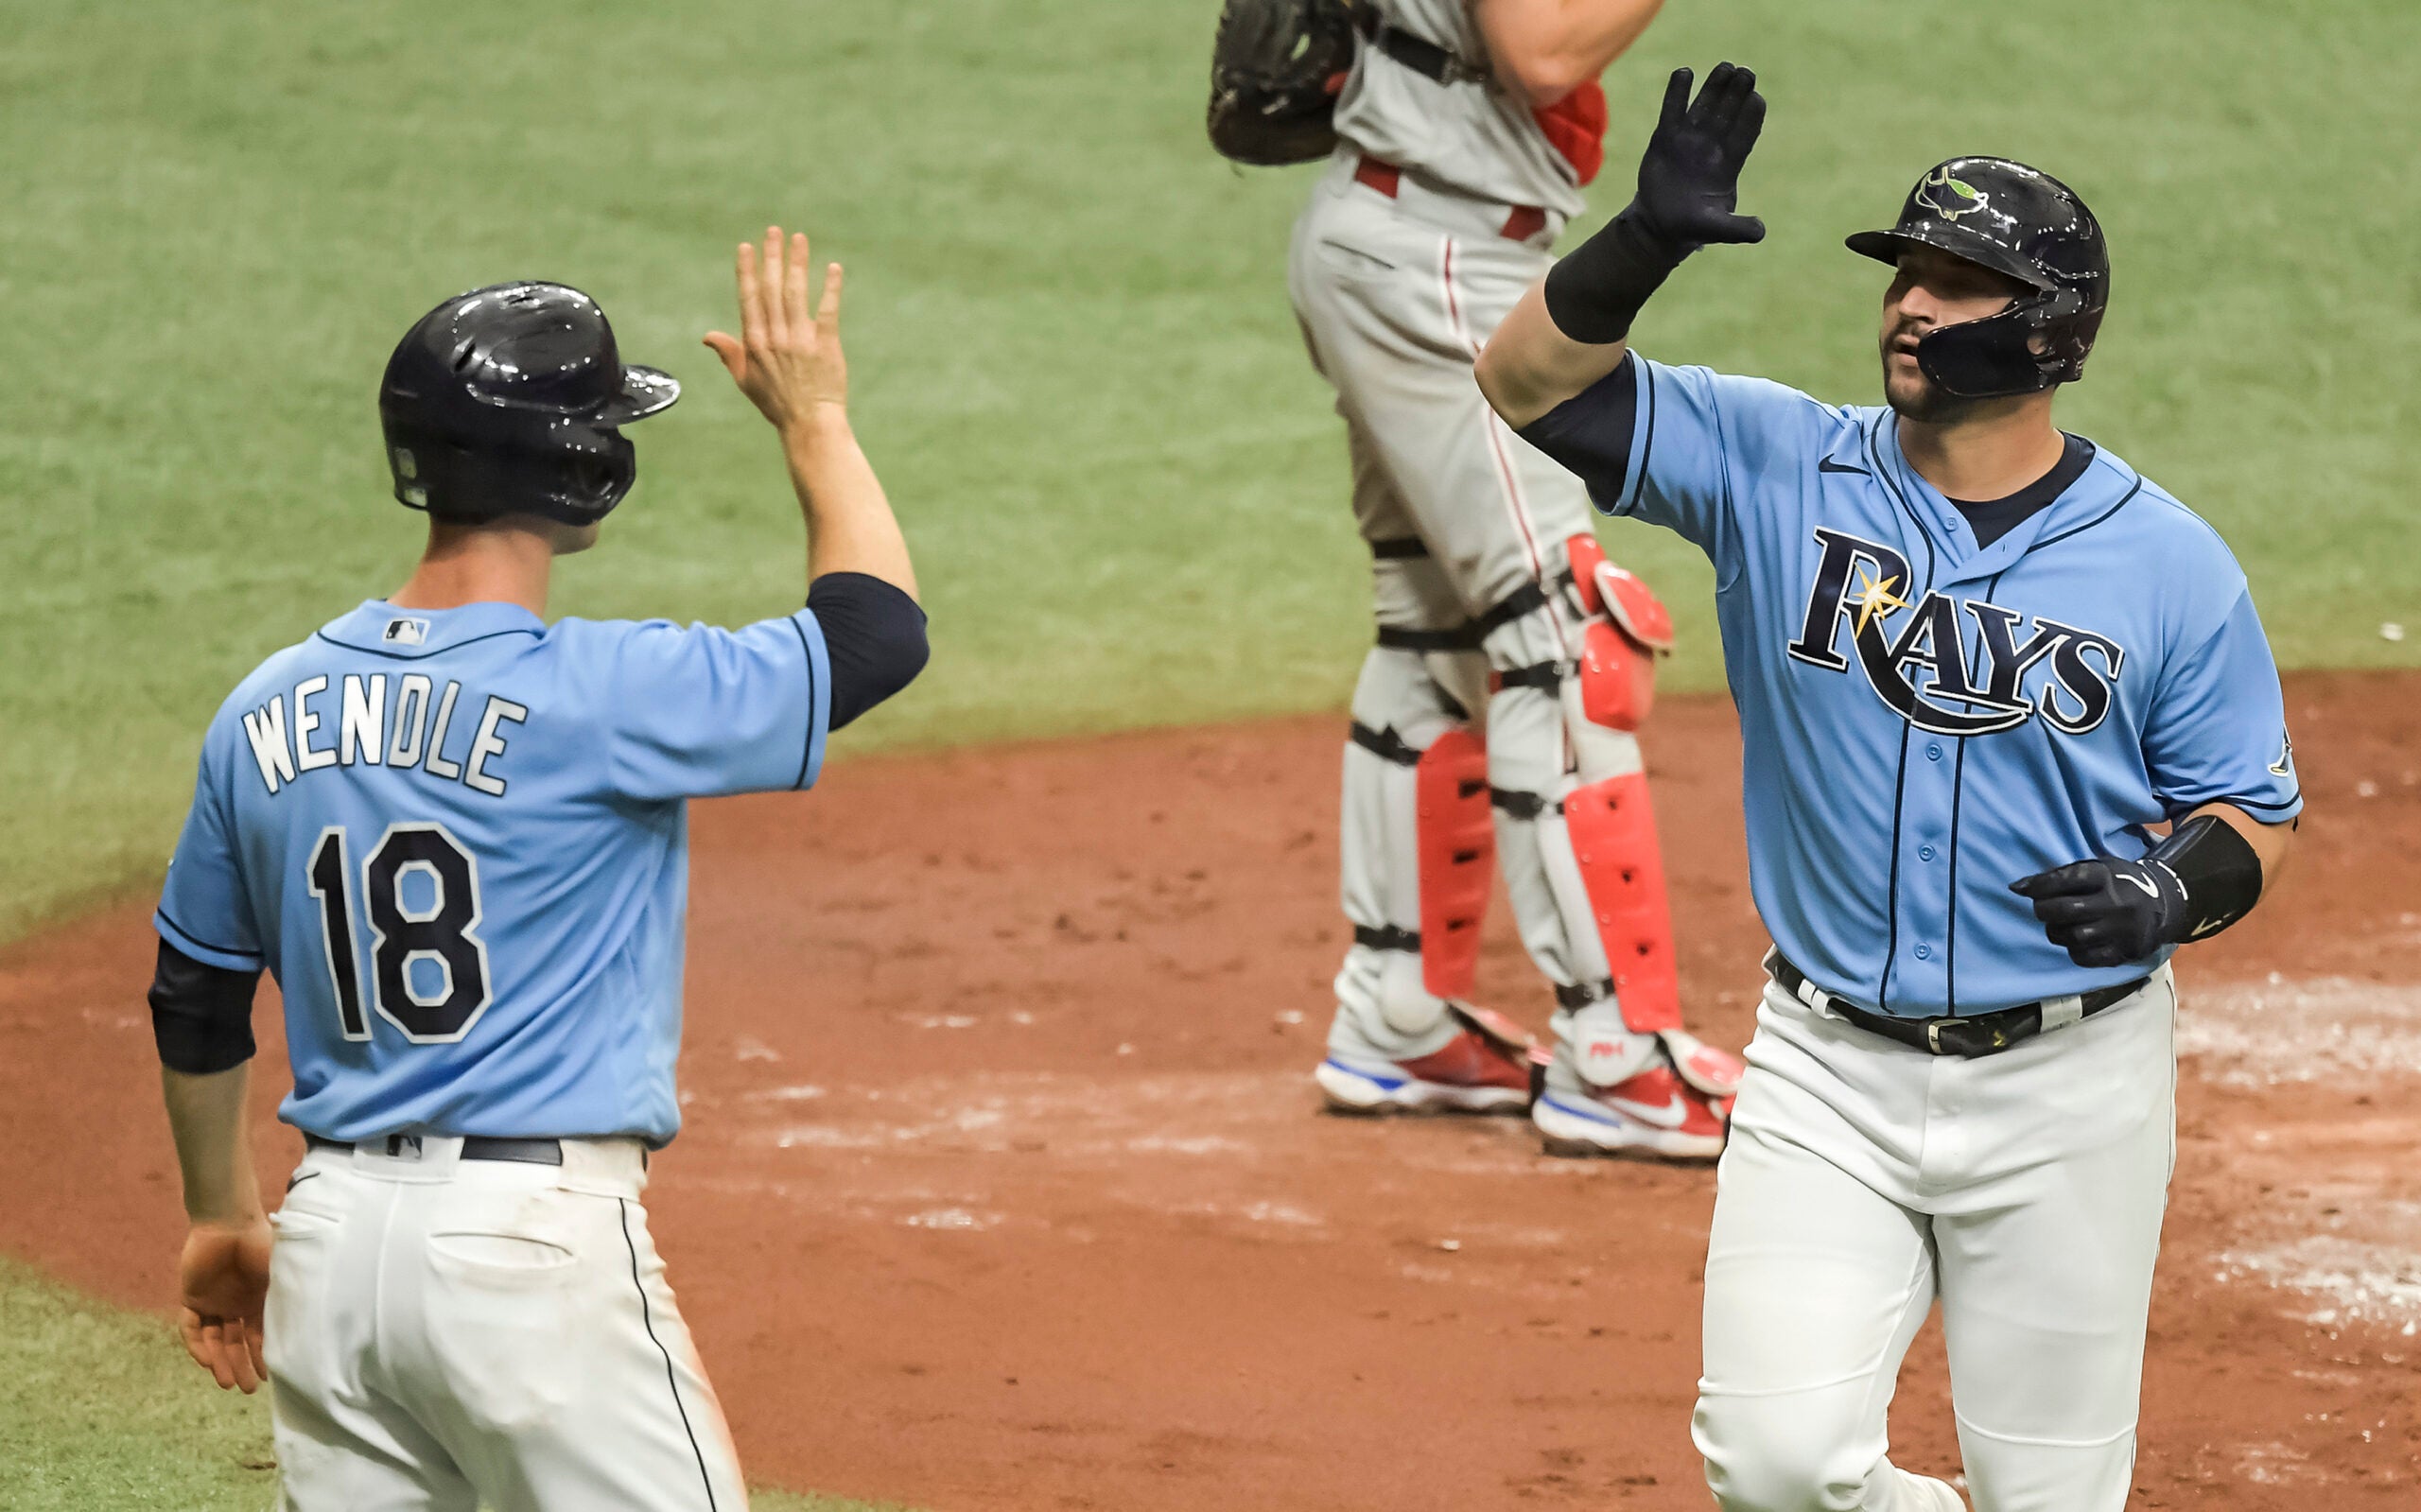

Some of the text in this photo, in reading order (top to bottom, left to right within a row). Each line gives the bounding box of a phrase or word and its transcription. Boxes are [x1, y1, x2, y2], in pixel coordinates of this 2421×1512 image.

[242, 673, 529, 797] WENDLE
[1787, 526, 2125, 735] RAYS
[306, 822, 493, 1044] 18
